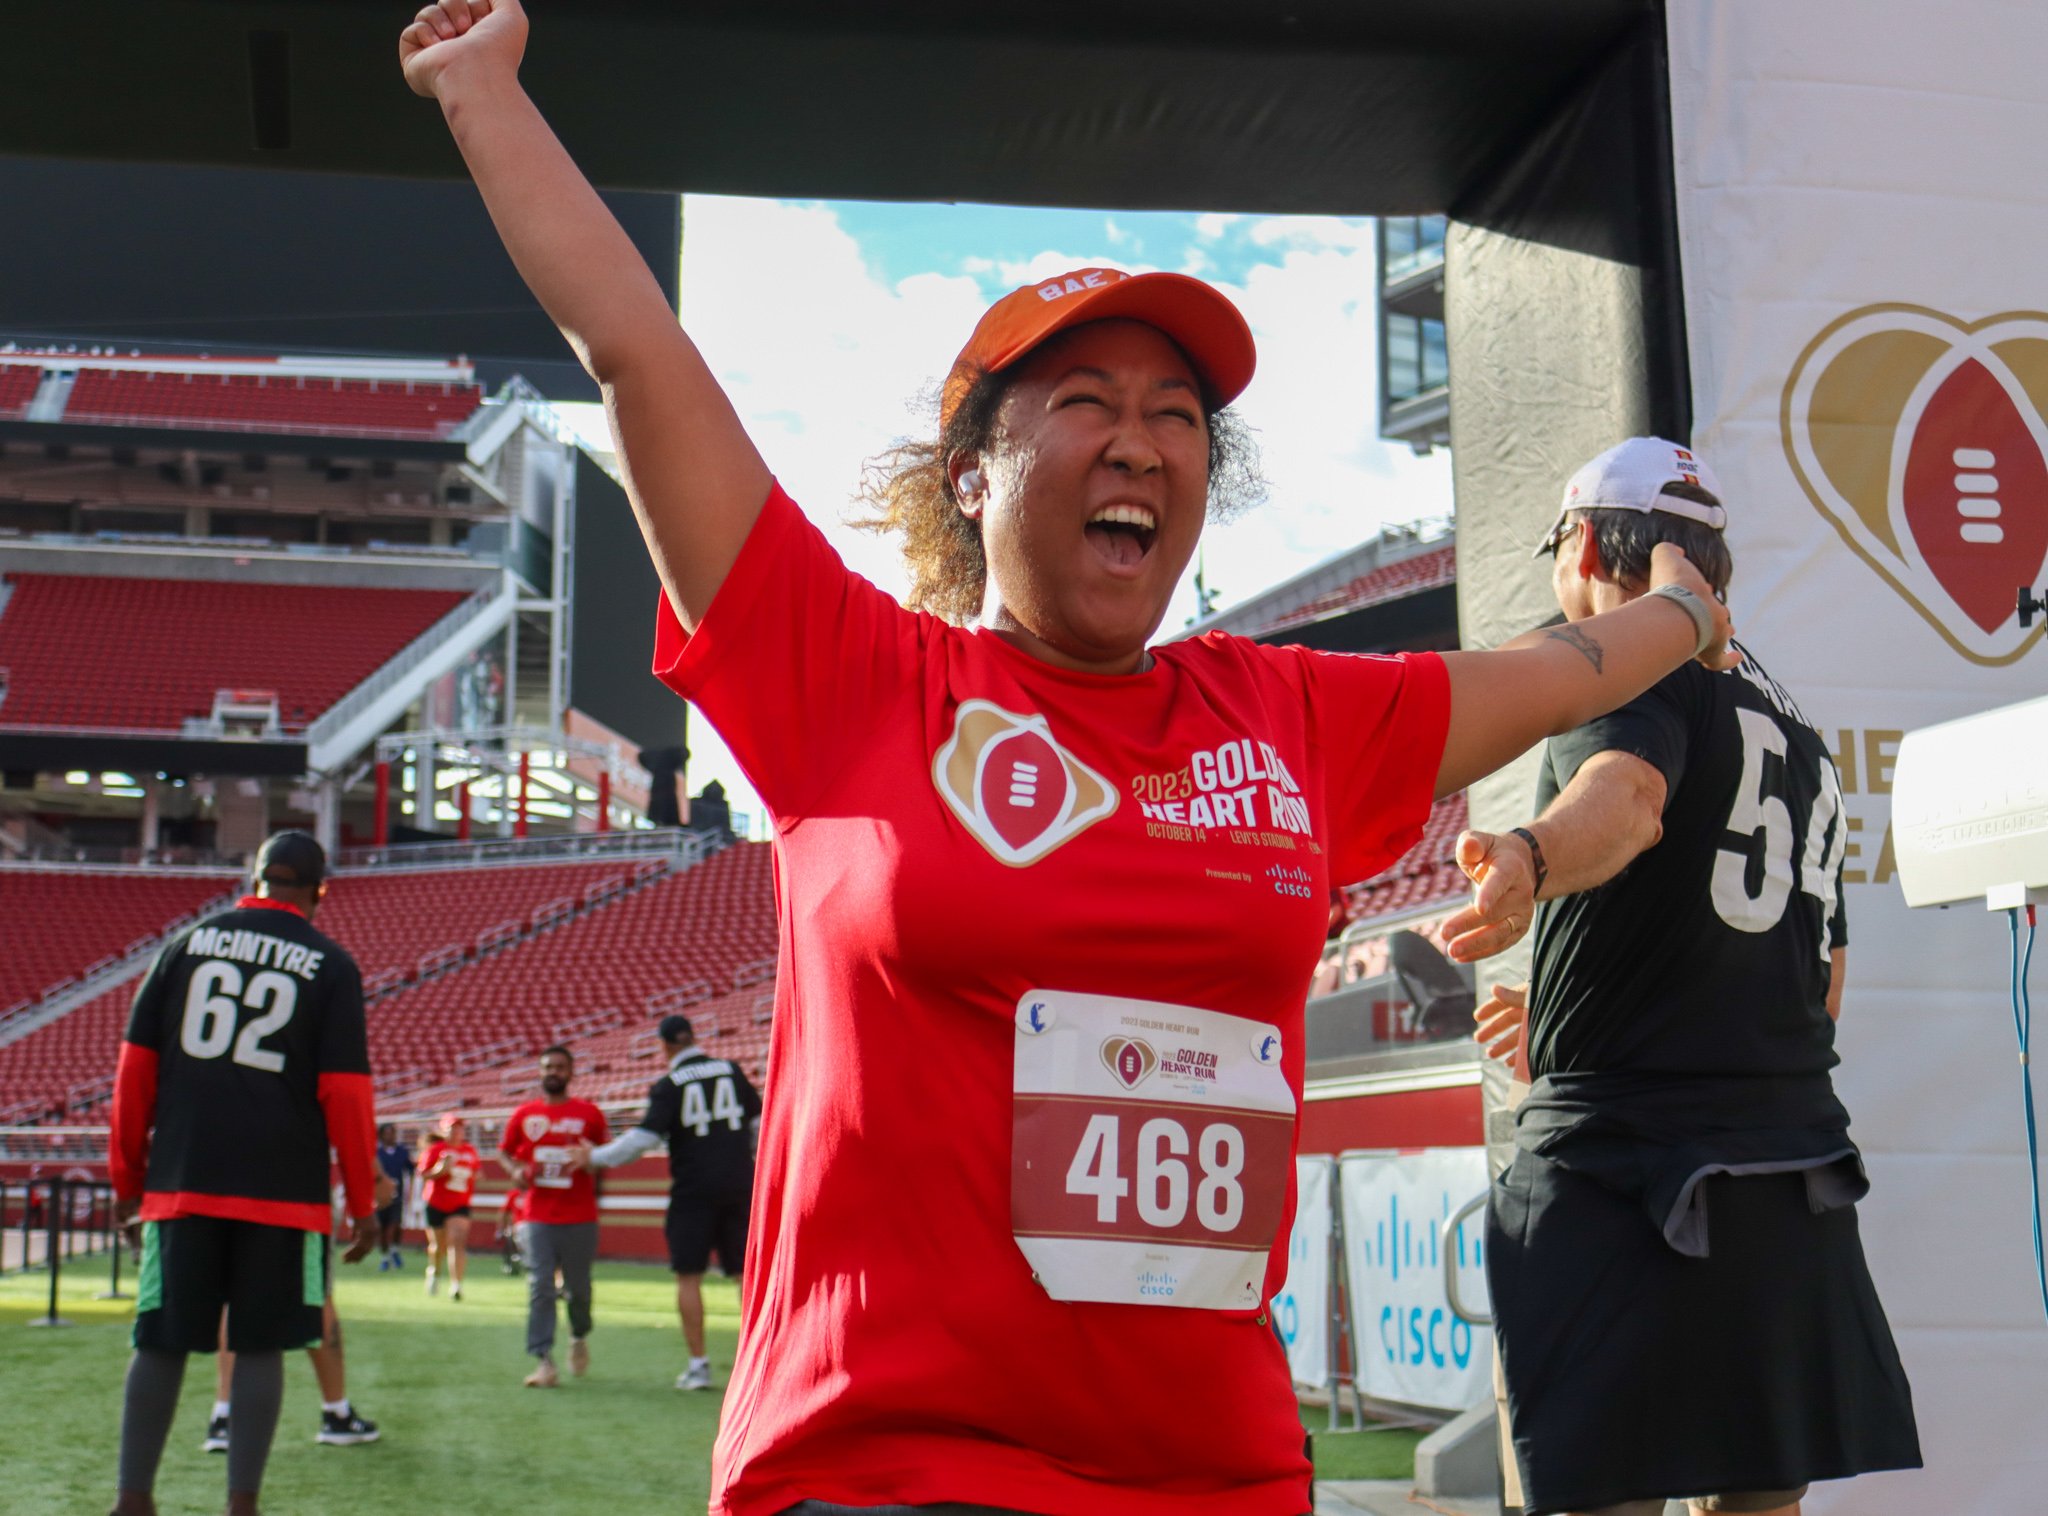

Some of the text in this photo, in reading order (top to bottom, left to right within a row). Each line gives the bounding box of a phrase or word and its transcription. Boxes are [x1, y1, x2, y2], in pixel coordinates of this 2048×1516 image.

[1037, 271, 1108, 302] BAE
[1132, 738, 1300, 802] 2023 GOLDN
[1139, 785, 1313, 838] HEART RUN
[1147, 822, 1193, 843] OCTOBER
[1194, 828, 1207, 844] 14
[1229, 829, 1260, 847] LEVI'S
[1260, 832, 1297, 851] STADIUM
[1710, 706, 1848, 964] 54
[1205, 868, 1252, 884] Presented by
[1274, 881, 1312, 899] CISCO
[180, 959, 298, 1073] 62
[1139, 1019, 1165, 1032] GOLDEN
[1164, 1022, 1186, 1034] HEART
[1186, 1026, 1200, 1036] RUN
[1160, 1059, 1192, 1075] HEART
[1194, 1067, 1217, 1081] RUN
[1176, 1048, 1219, 1068] GOLDEN
[681, 1076, 745, 1137] 44
[1065, 1113, 1245, 1233] 468
[1140, 1285, 1174, 1296] CISCO
[1380, 1305, 1472, 1371] CISCO
